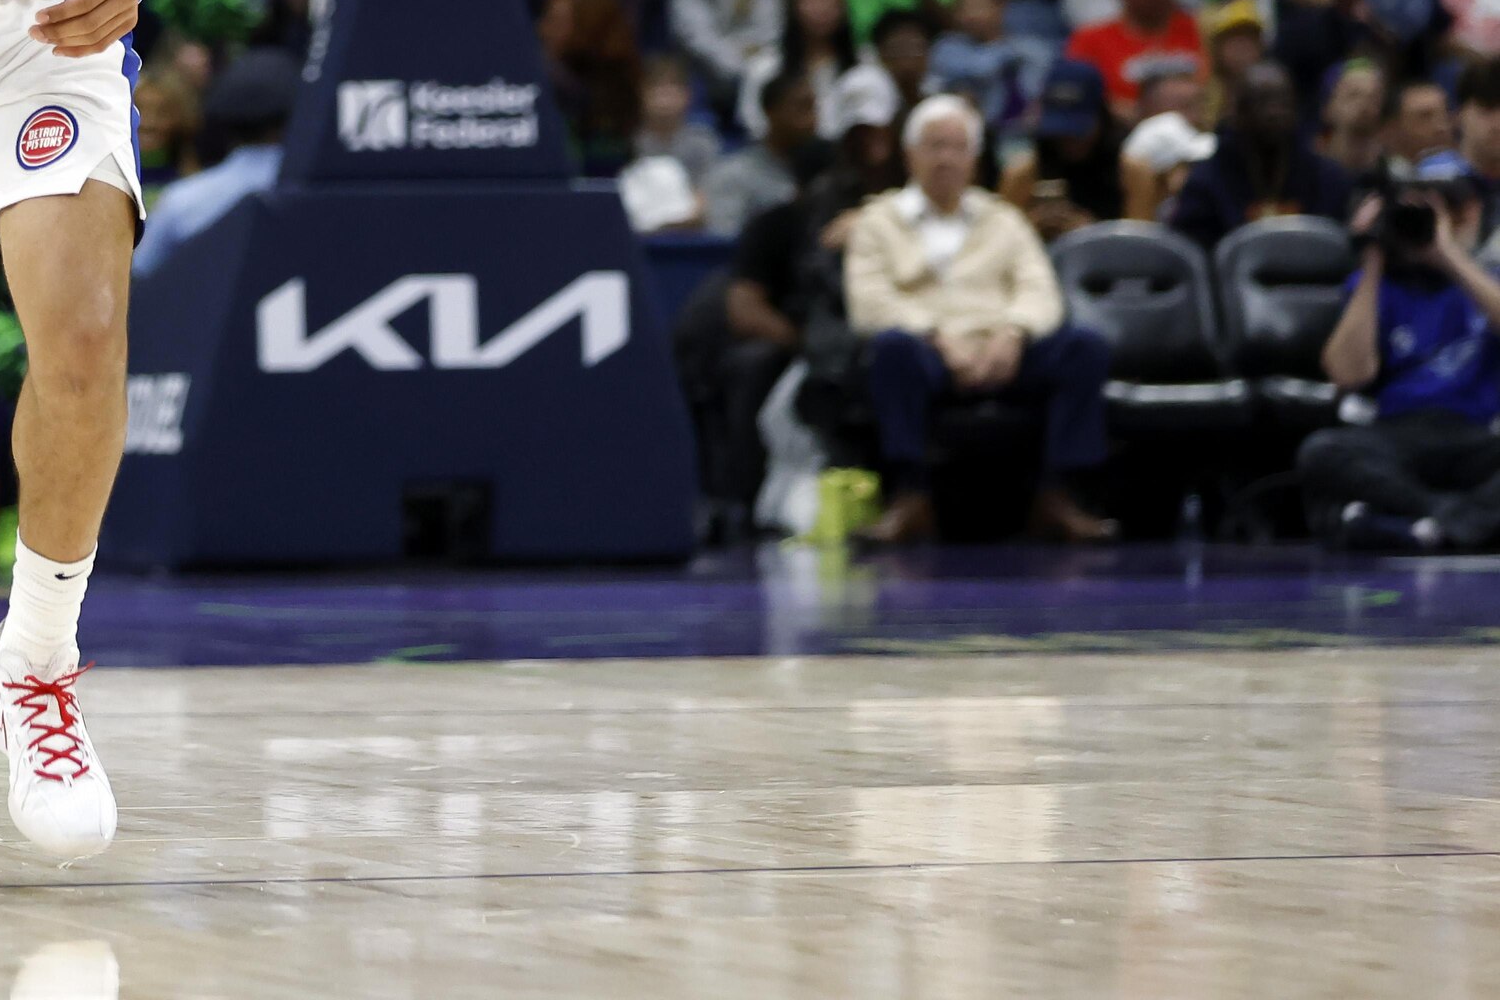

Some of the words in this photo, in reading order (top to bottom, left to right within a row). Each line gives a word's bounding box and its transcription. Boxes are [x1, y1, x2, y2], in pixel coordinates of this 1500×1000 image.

[26, 136, 63, 152] PISTONS
[28, 126, 65, 141] DETROIT
[410, 114, 539, 149] Federal
[256, 270, 631, 373] KIA
